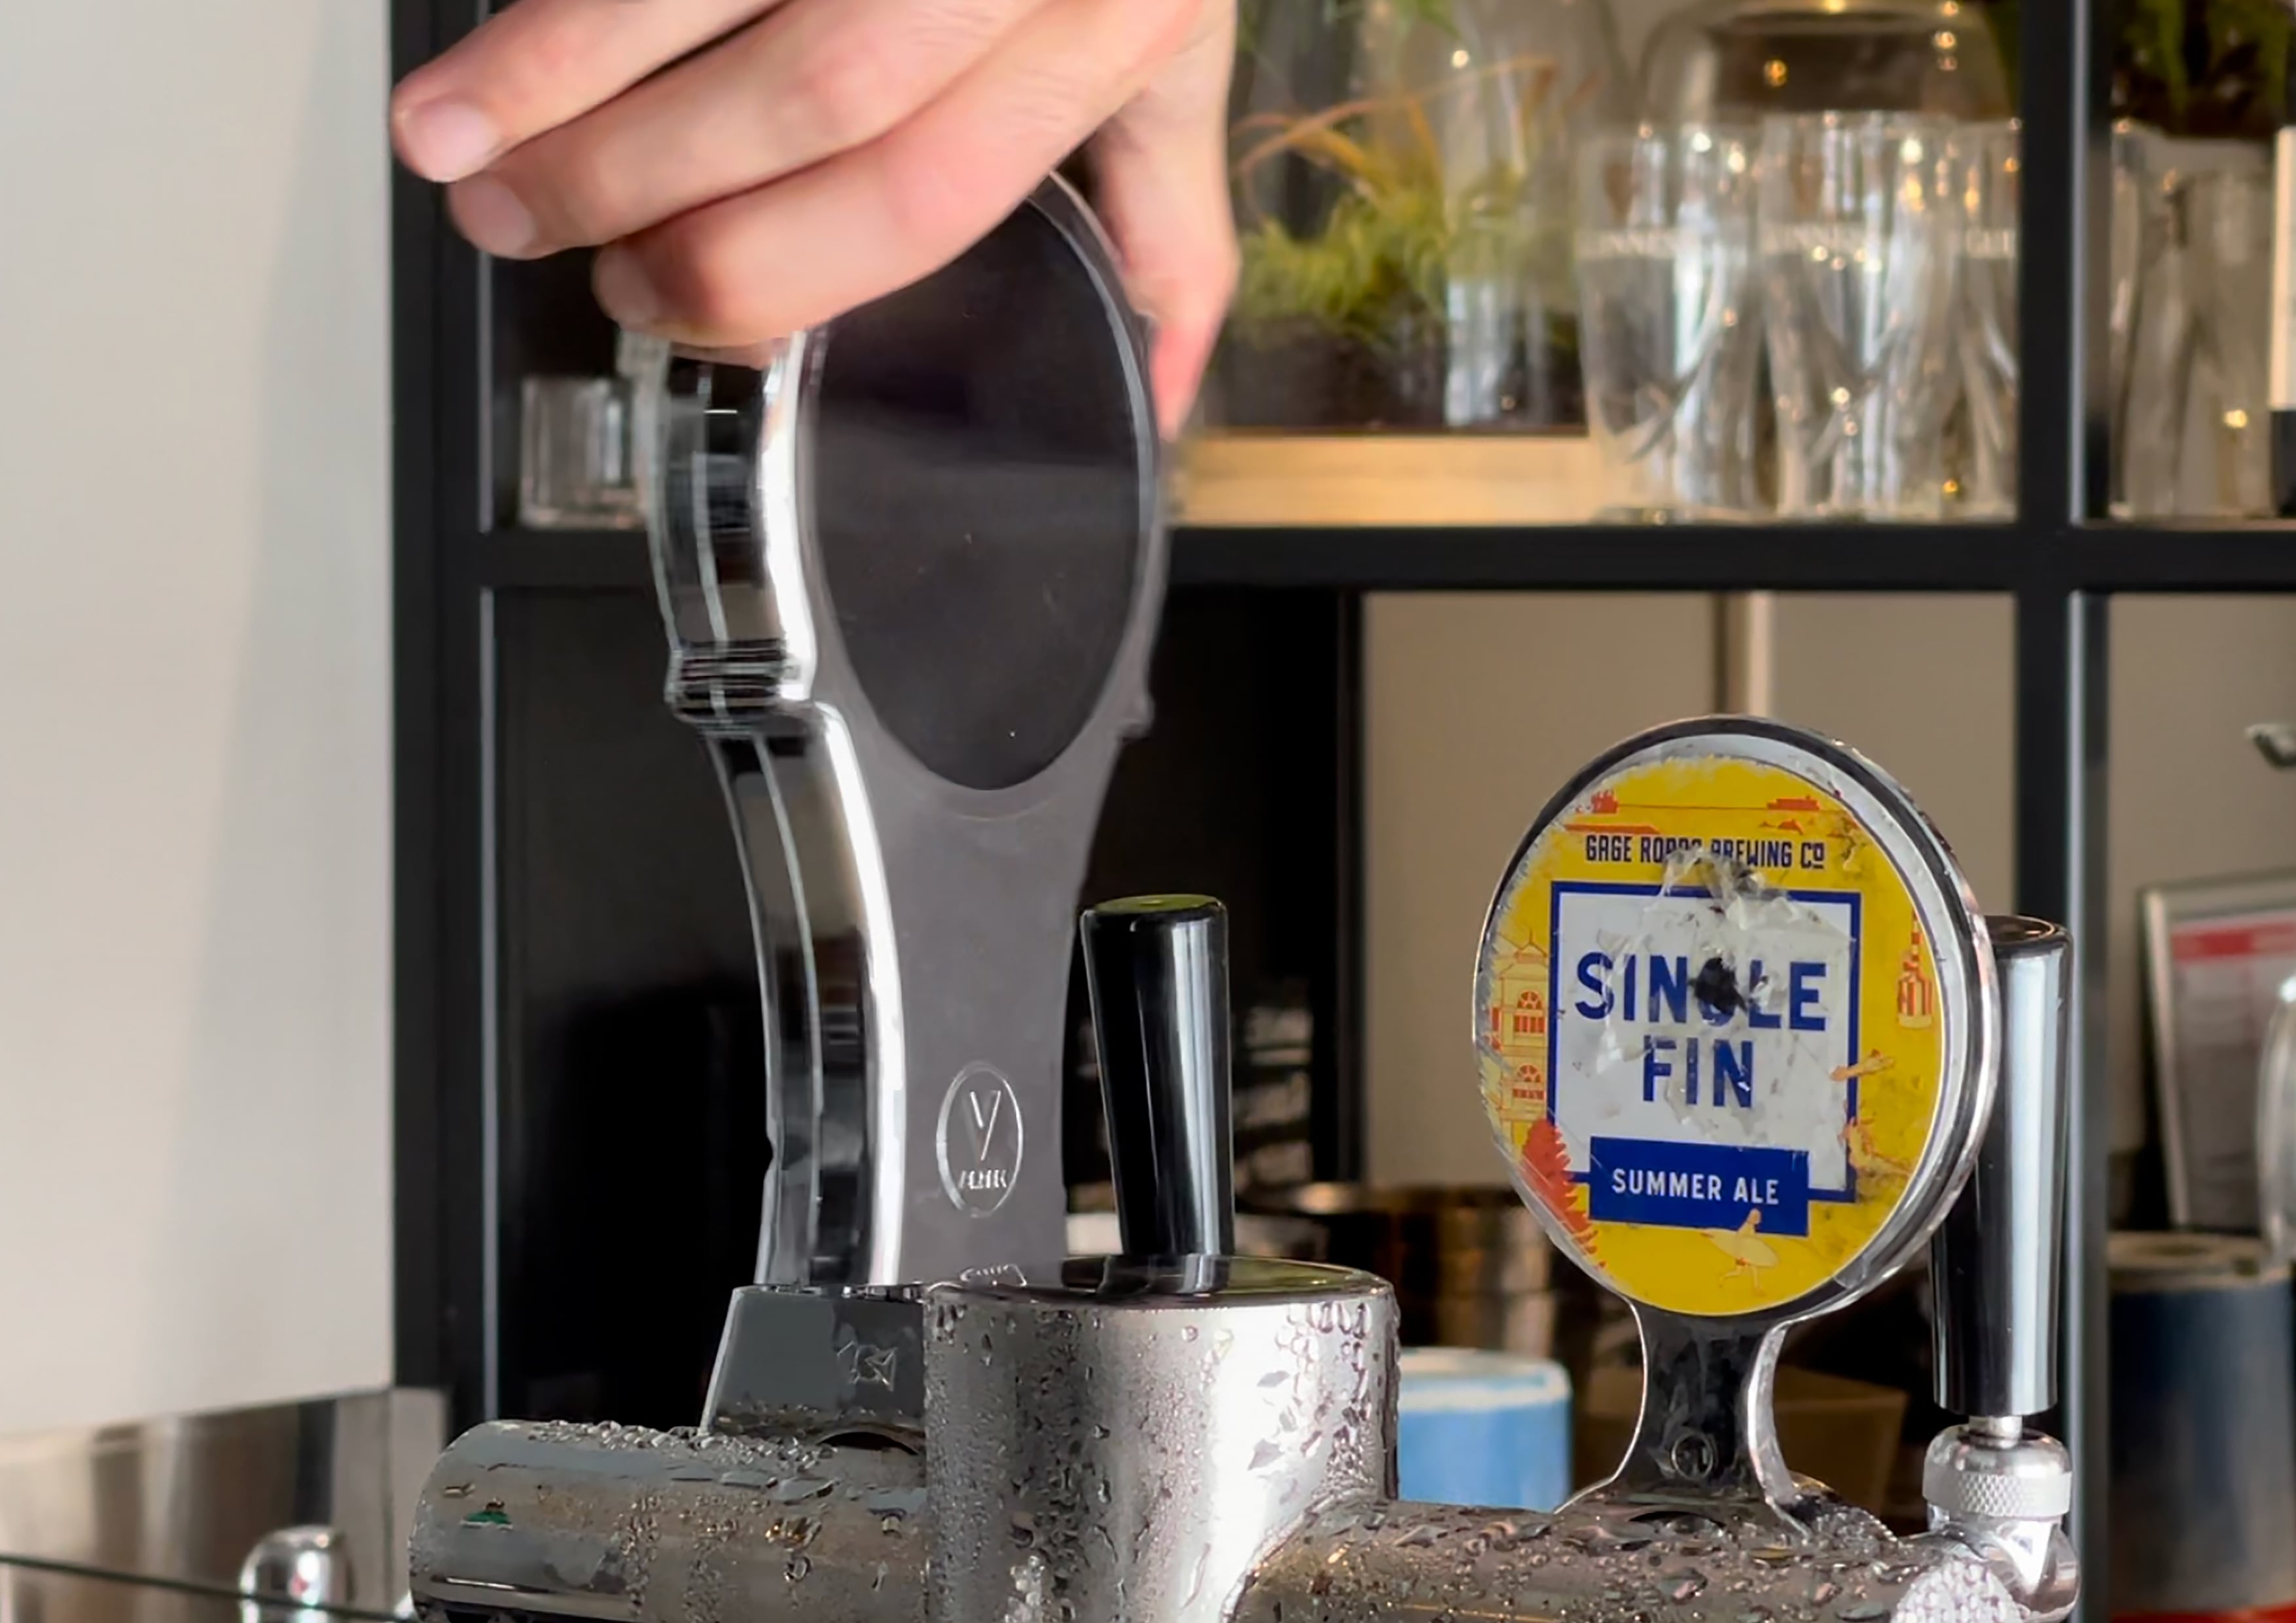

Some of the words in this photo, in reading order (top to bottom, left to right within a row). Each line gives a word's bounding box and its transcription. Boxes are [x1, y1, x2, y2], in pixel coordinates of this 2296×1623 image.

[1586, 834, 1632, 863] GAGE
[1643, 1035, 1753, 1108] FIN
[1611, 1168, 1722, 1202] SUMMER
[1733, 1177, 1779, 1205] ALE
